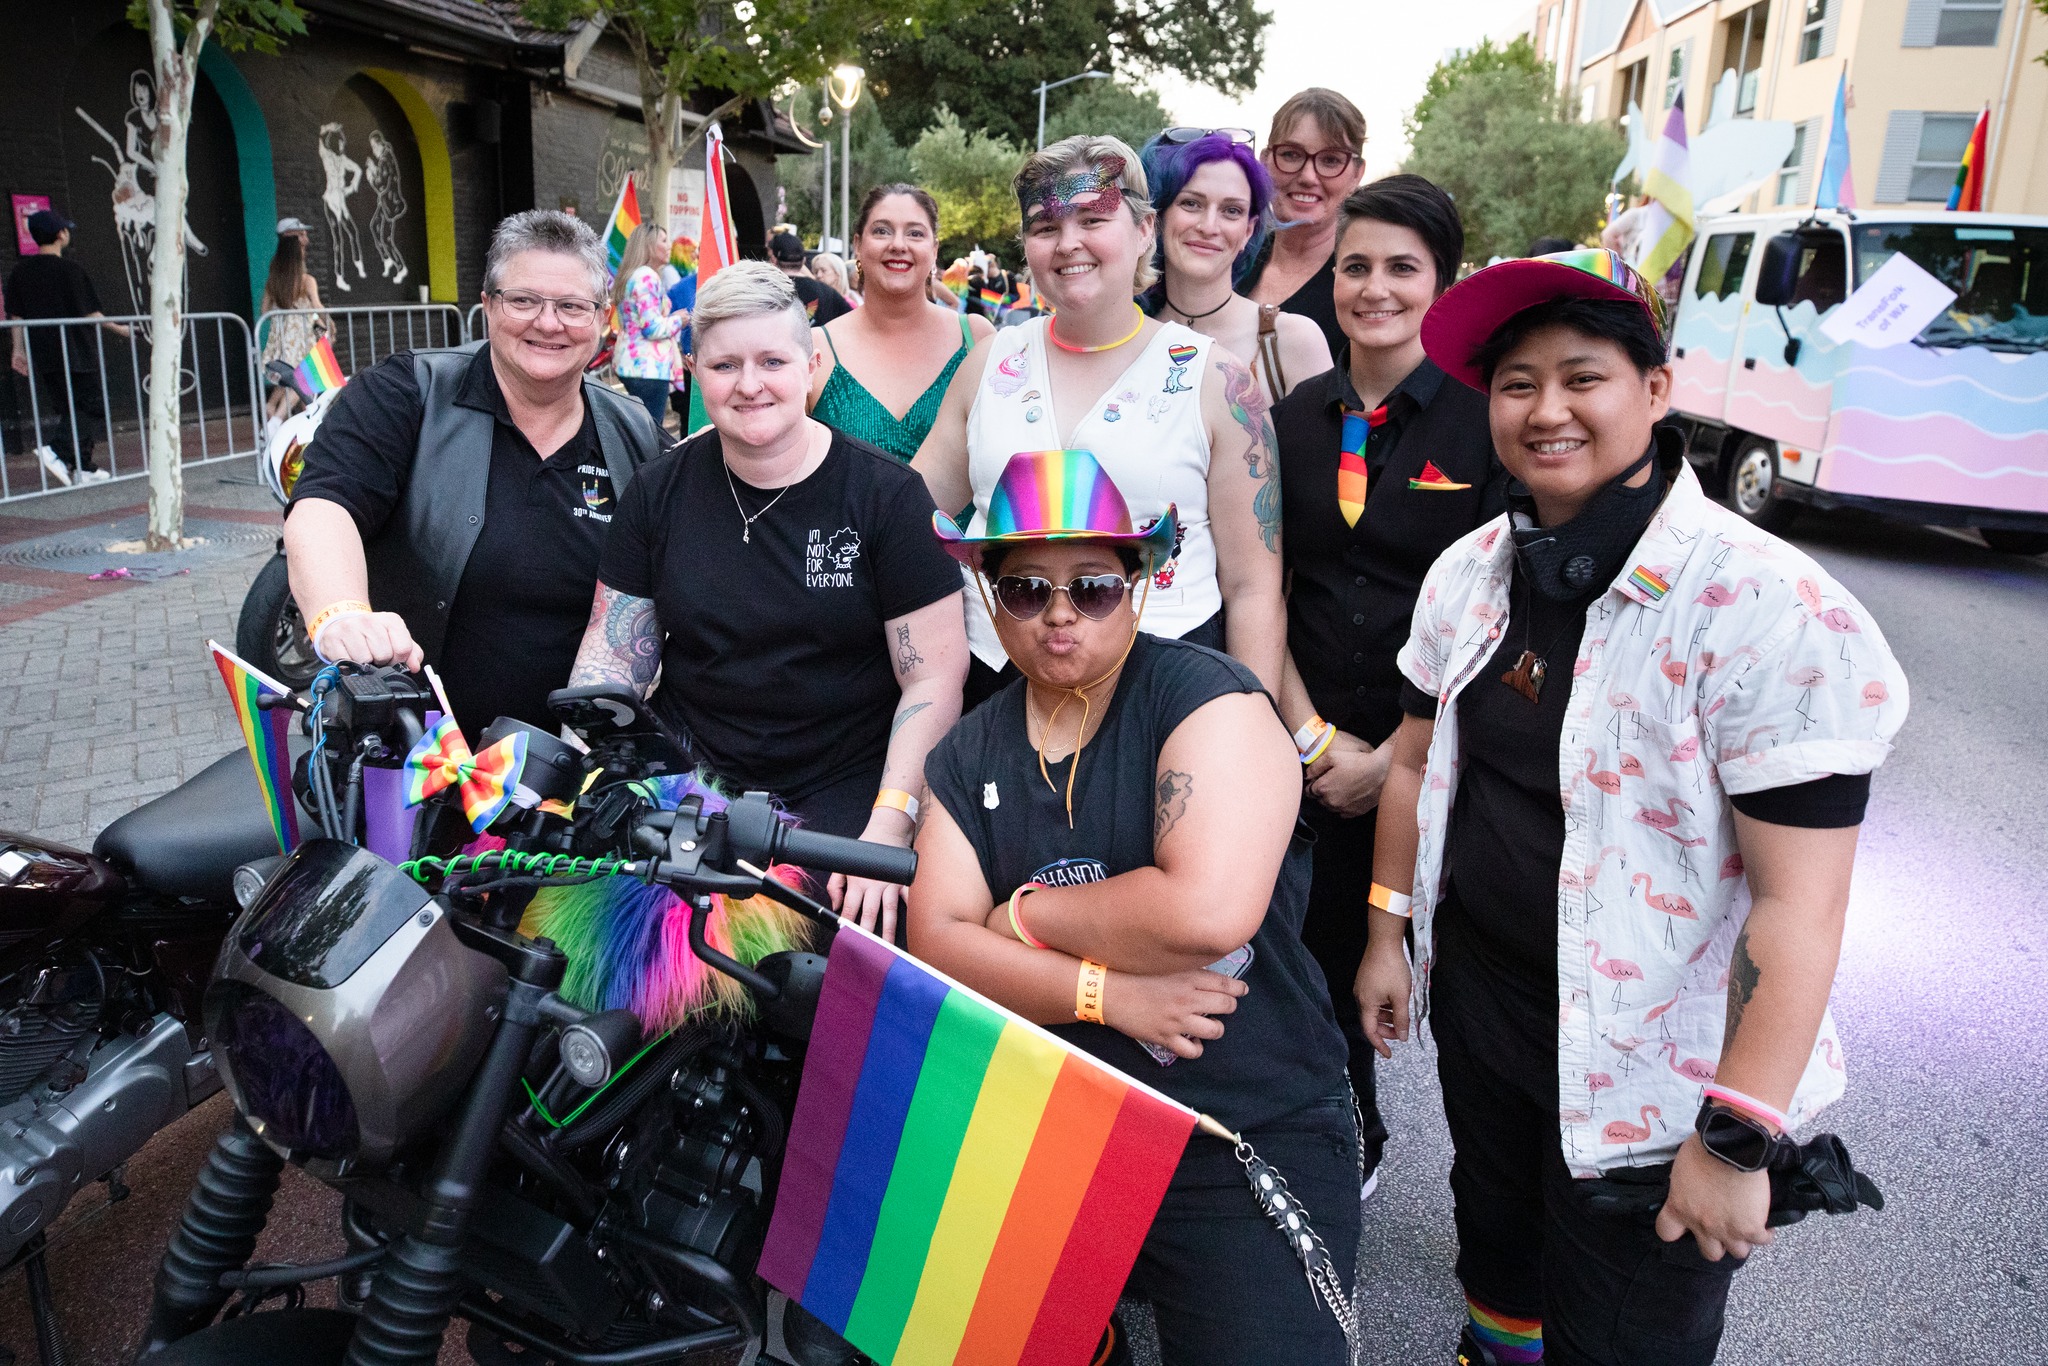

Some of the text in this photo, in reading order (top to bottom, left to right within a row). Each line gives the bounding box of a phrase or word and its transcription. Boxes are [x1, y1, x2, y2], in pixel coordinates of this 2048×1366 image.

[677, 192, 688, 203] NO
[1856, 285, 1906, 328] TransFolk
[1889, 303, 1909, 320] WA
[577, 464, 595, 475] PRIDE
[806, 543, 825, 558] NOT
[806, 557, 824, 573] FOR
[806, 572, 854, 588] EVERYONE
